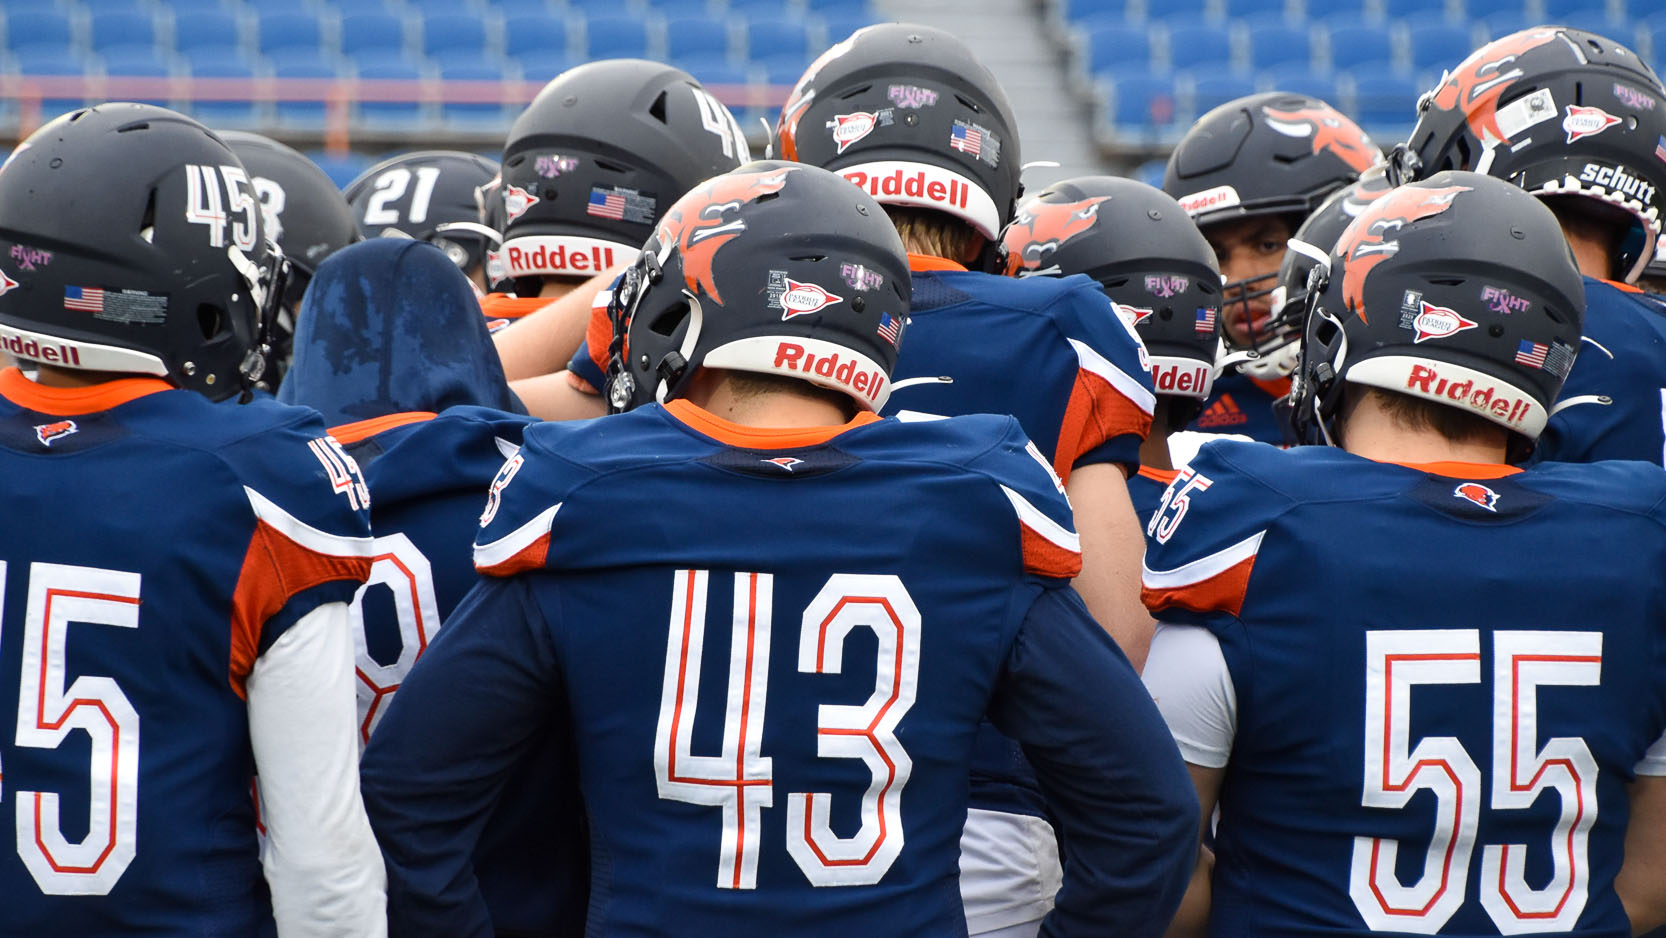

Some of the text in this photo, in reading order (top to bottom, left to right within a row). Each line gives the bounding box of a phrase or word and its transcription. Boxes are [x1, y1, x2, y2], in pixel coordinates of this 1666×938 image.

[185, 164, 256, 251] 45
[363, 167, 440, 225] 21
[1580, 163, 1656, 204] schutt
[508, 245, 614, 271] Riddell
[0, 335, 80, 366] iddell
[774, 342, 884, 401] Riddell
[1407, 363, 1531, 424] Riddell
[307, 436, 370, 511] 45
[1147, 464, 1214, 545] 55
[0, 561, 142, 896] 5
[654, 569, 921, 889] 43
[1349, 629, 1603, 936] 55
